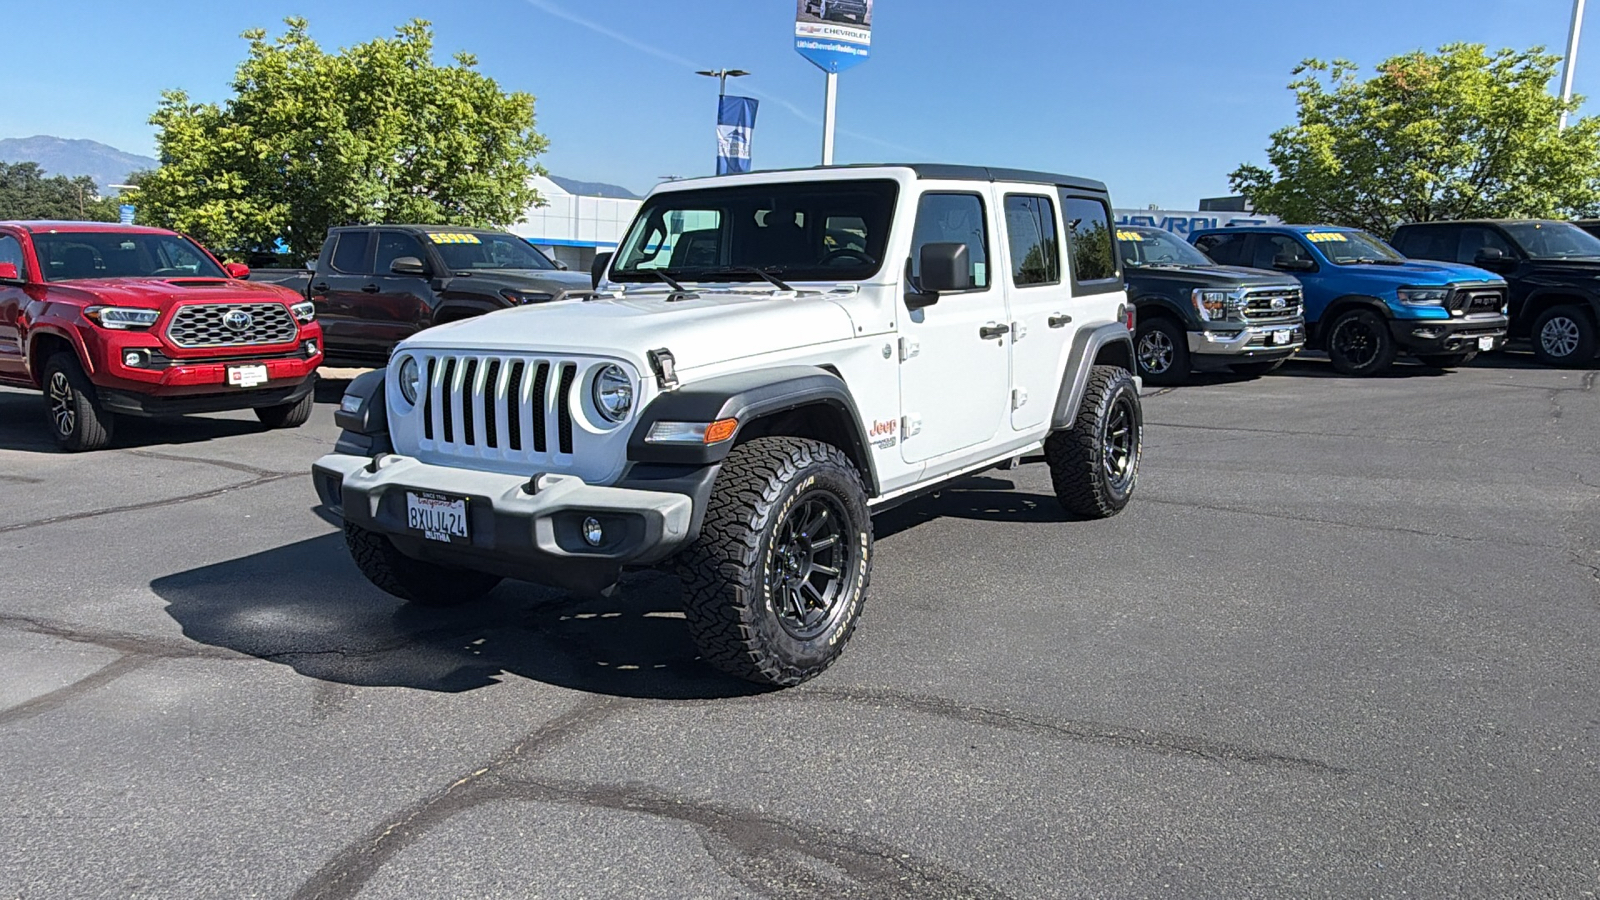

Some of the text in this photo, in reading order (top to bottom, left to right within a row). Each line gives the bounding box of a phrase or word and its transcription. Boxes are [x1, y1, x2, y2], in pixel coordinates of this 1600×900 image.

[823, 27, 867, 39] CHEVROLET
[1114, 215, 1267, 234] HEVROL
[869, 419, 897, 437] Jeep
[795, 474, 816, 497] T/A
[410, 507, 465, 537] 8XUJ424
[828, 531, 870, 647] BFGoodrich
